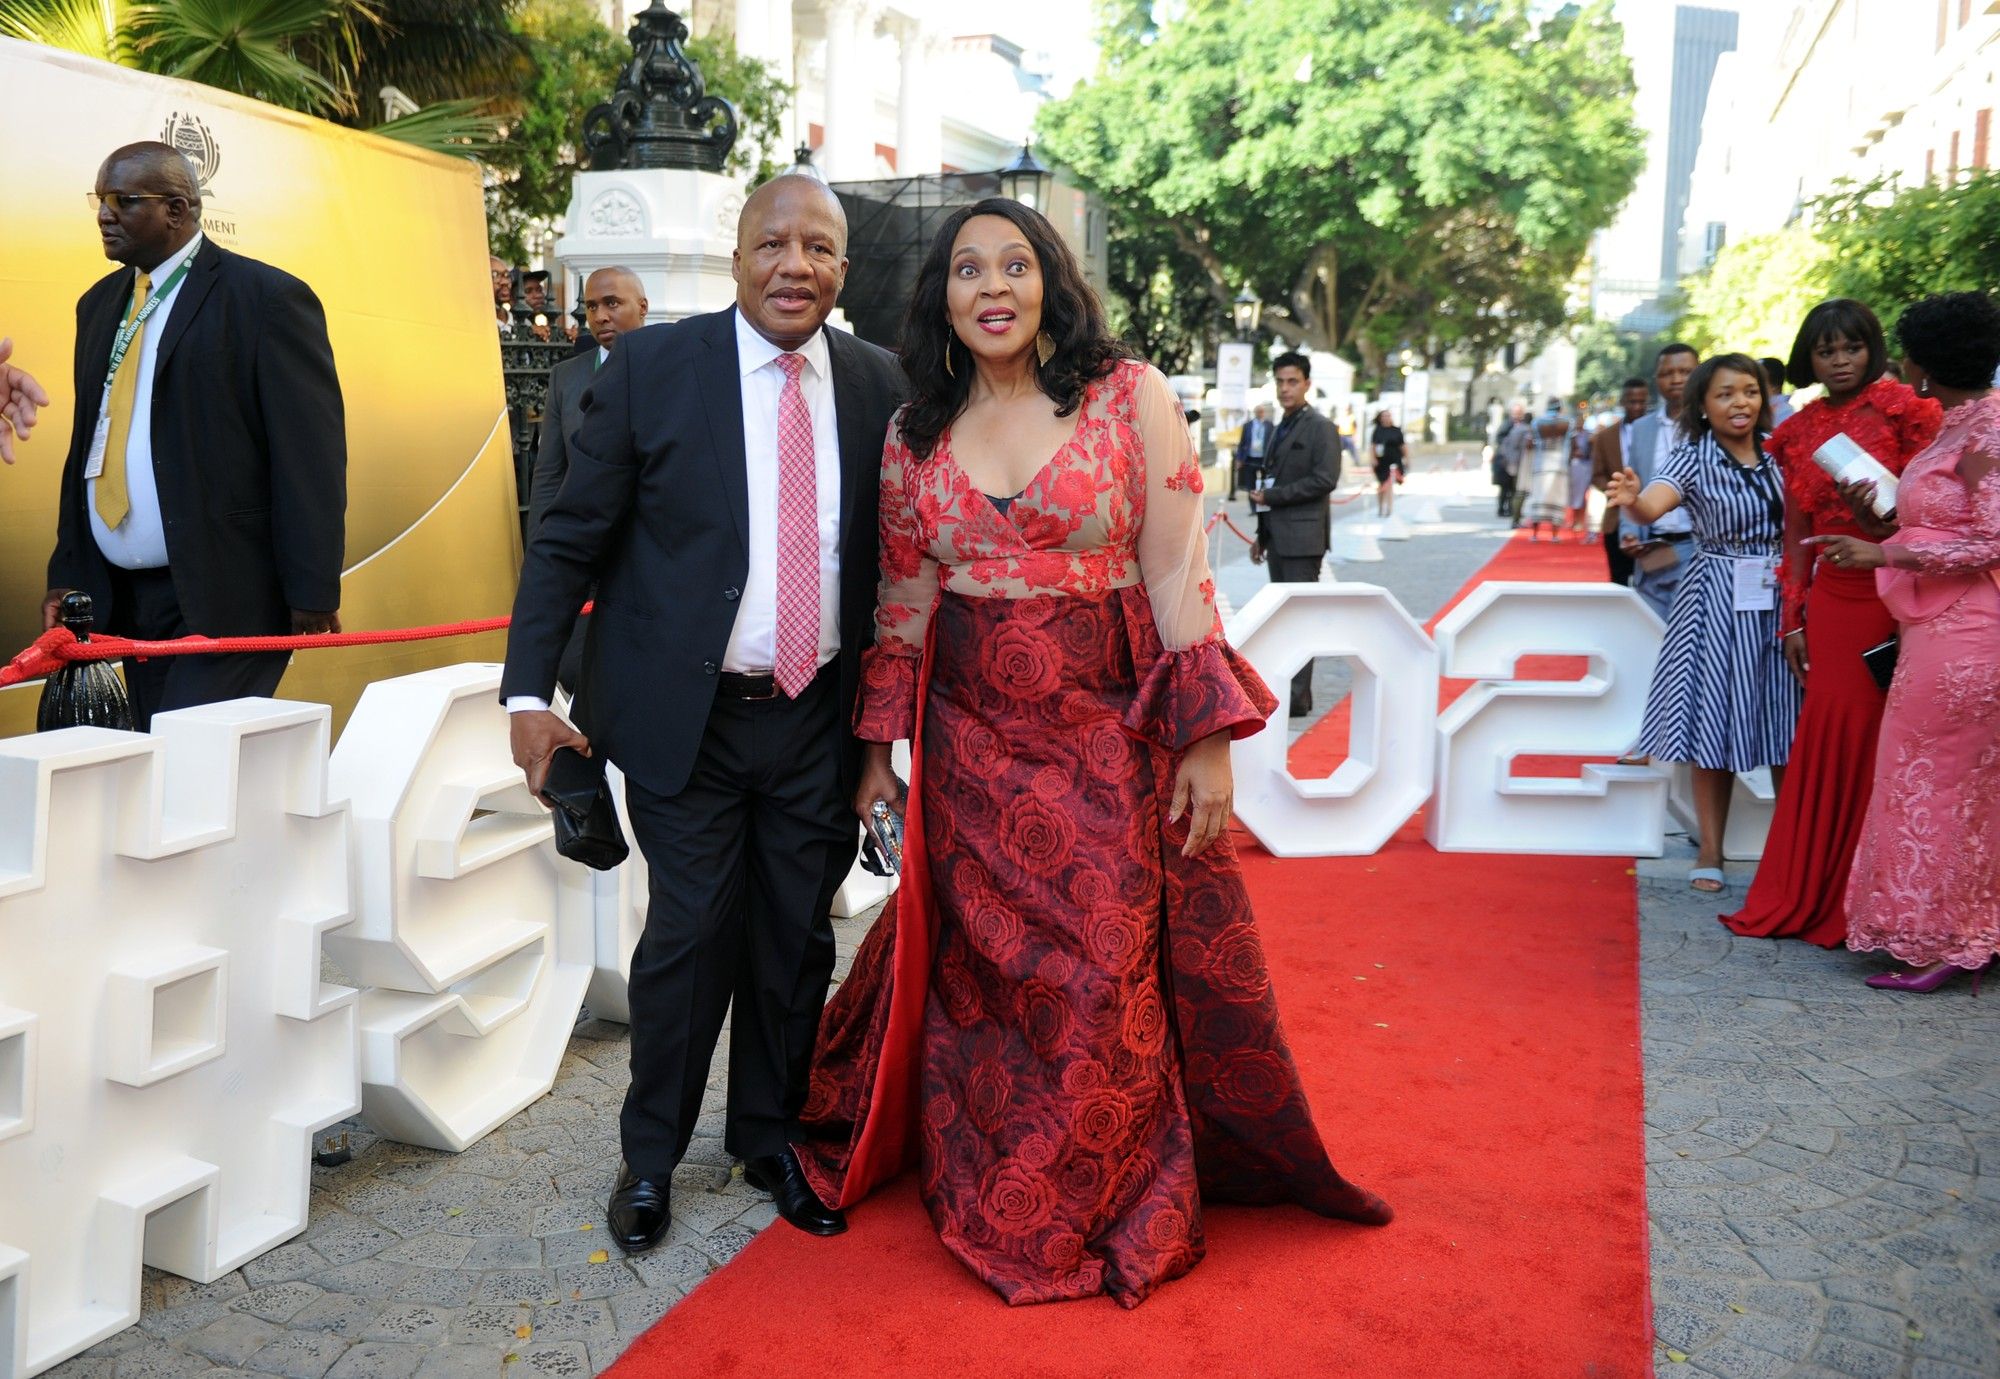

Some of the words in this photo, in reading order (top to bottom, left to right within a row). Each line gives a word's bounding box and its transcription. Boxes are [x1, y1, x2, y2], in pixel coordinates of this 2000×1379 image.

[202, 218, 237, 235] MENT
[137, 296, 161, 322] ADDRESS
[123, 319, 141, 343] NATION
[118, 341, 128, 354] THE
[114, 351, 124, 363] OF
